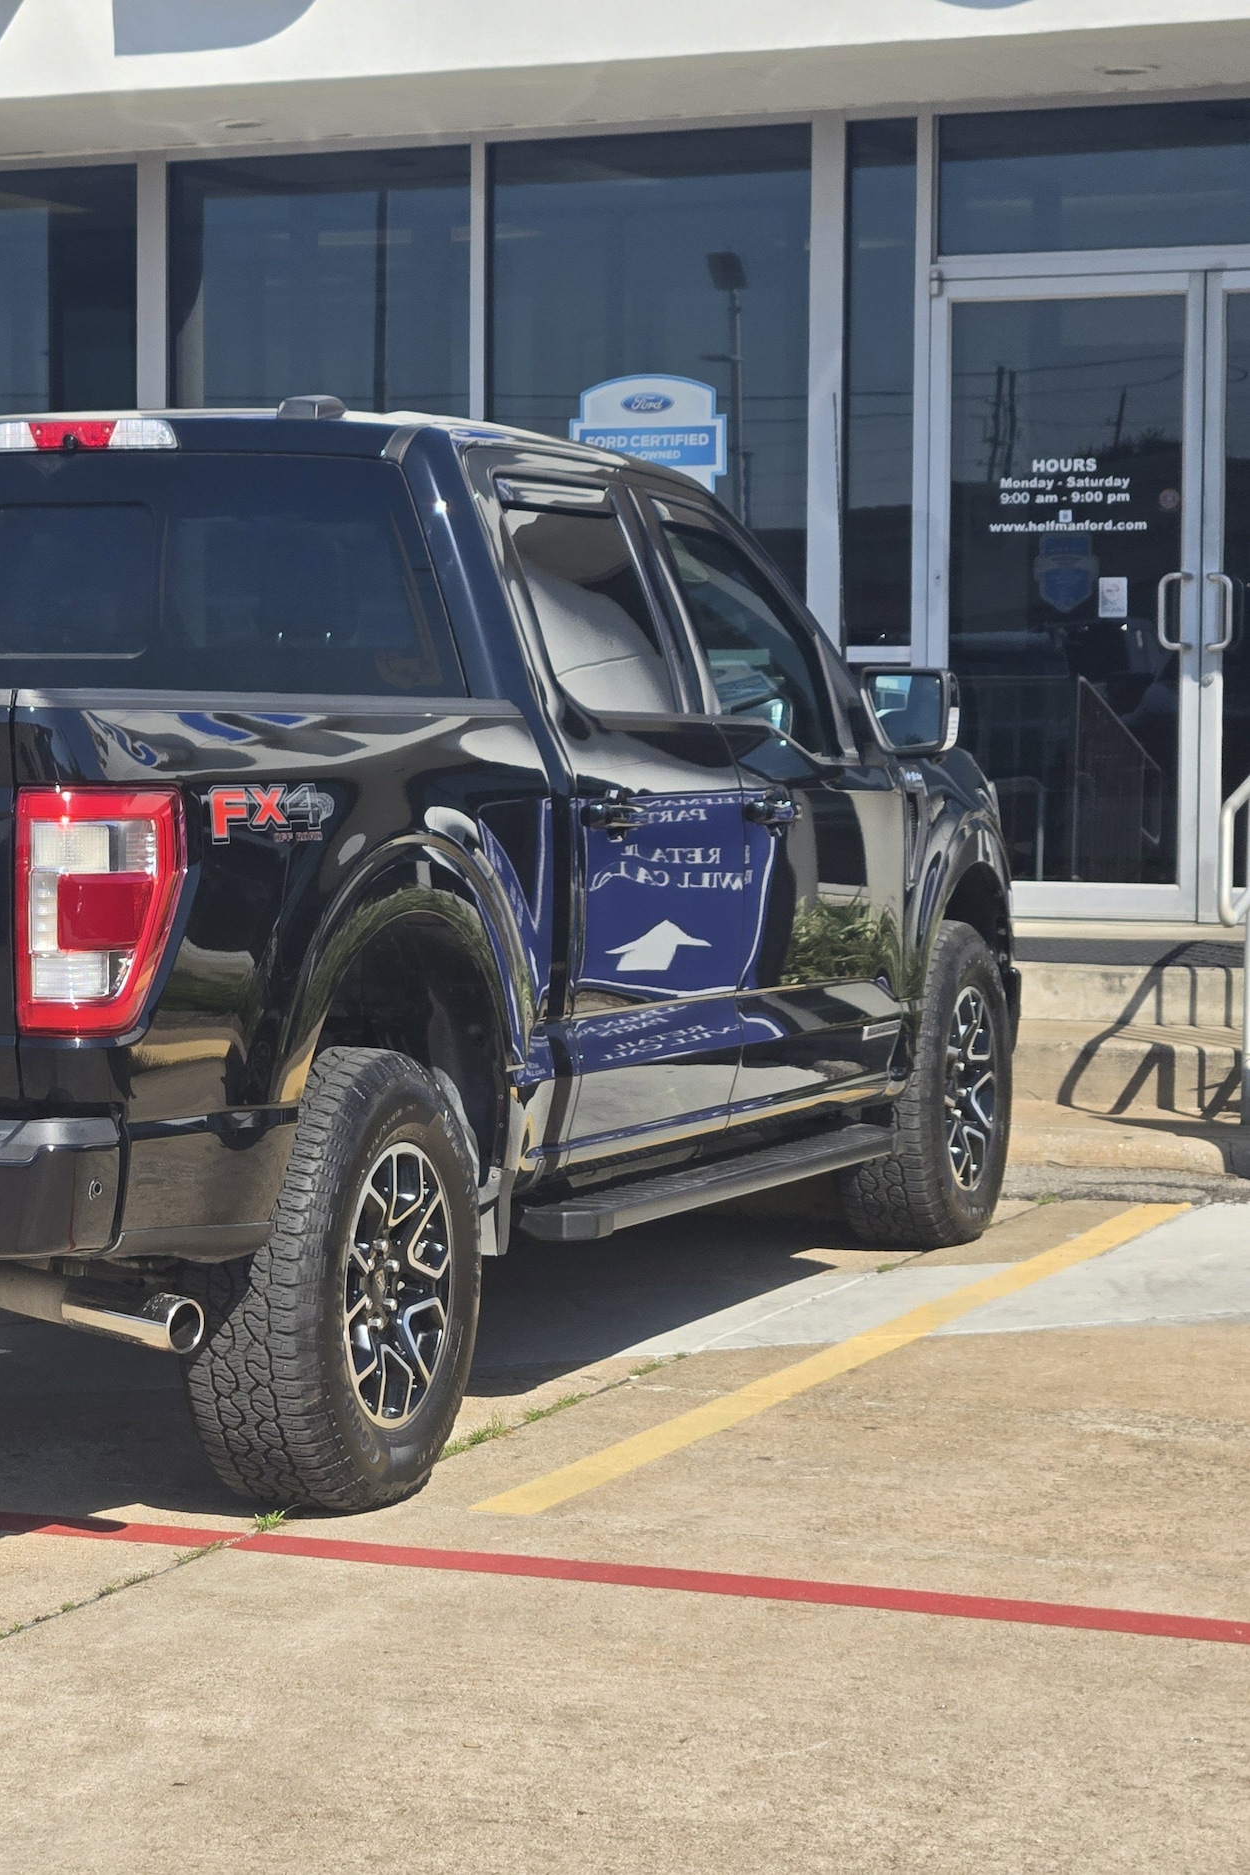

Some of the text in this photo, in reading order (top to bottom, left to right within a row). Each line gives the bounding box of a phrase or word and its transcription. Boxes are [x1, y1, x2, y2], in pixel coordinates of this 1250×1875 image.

[585, 433, 710, 449] FORD CERTIFIED
[1032, 458, 1097, 473] HOURS
[1000, 477, 1054, 491] Monday
[1066, 476, 1130, 489] Saturday
[1000, 492, 1031, 505] 9:00
[1035, 493, 1058, 504] am
[1071, 491, 1103, 503] 9:00
[1107, 492, 1130, 505] pm
[989, 519, 1148, 533] www.helfmanford.com
[208, 783, 322, 845] FX4
